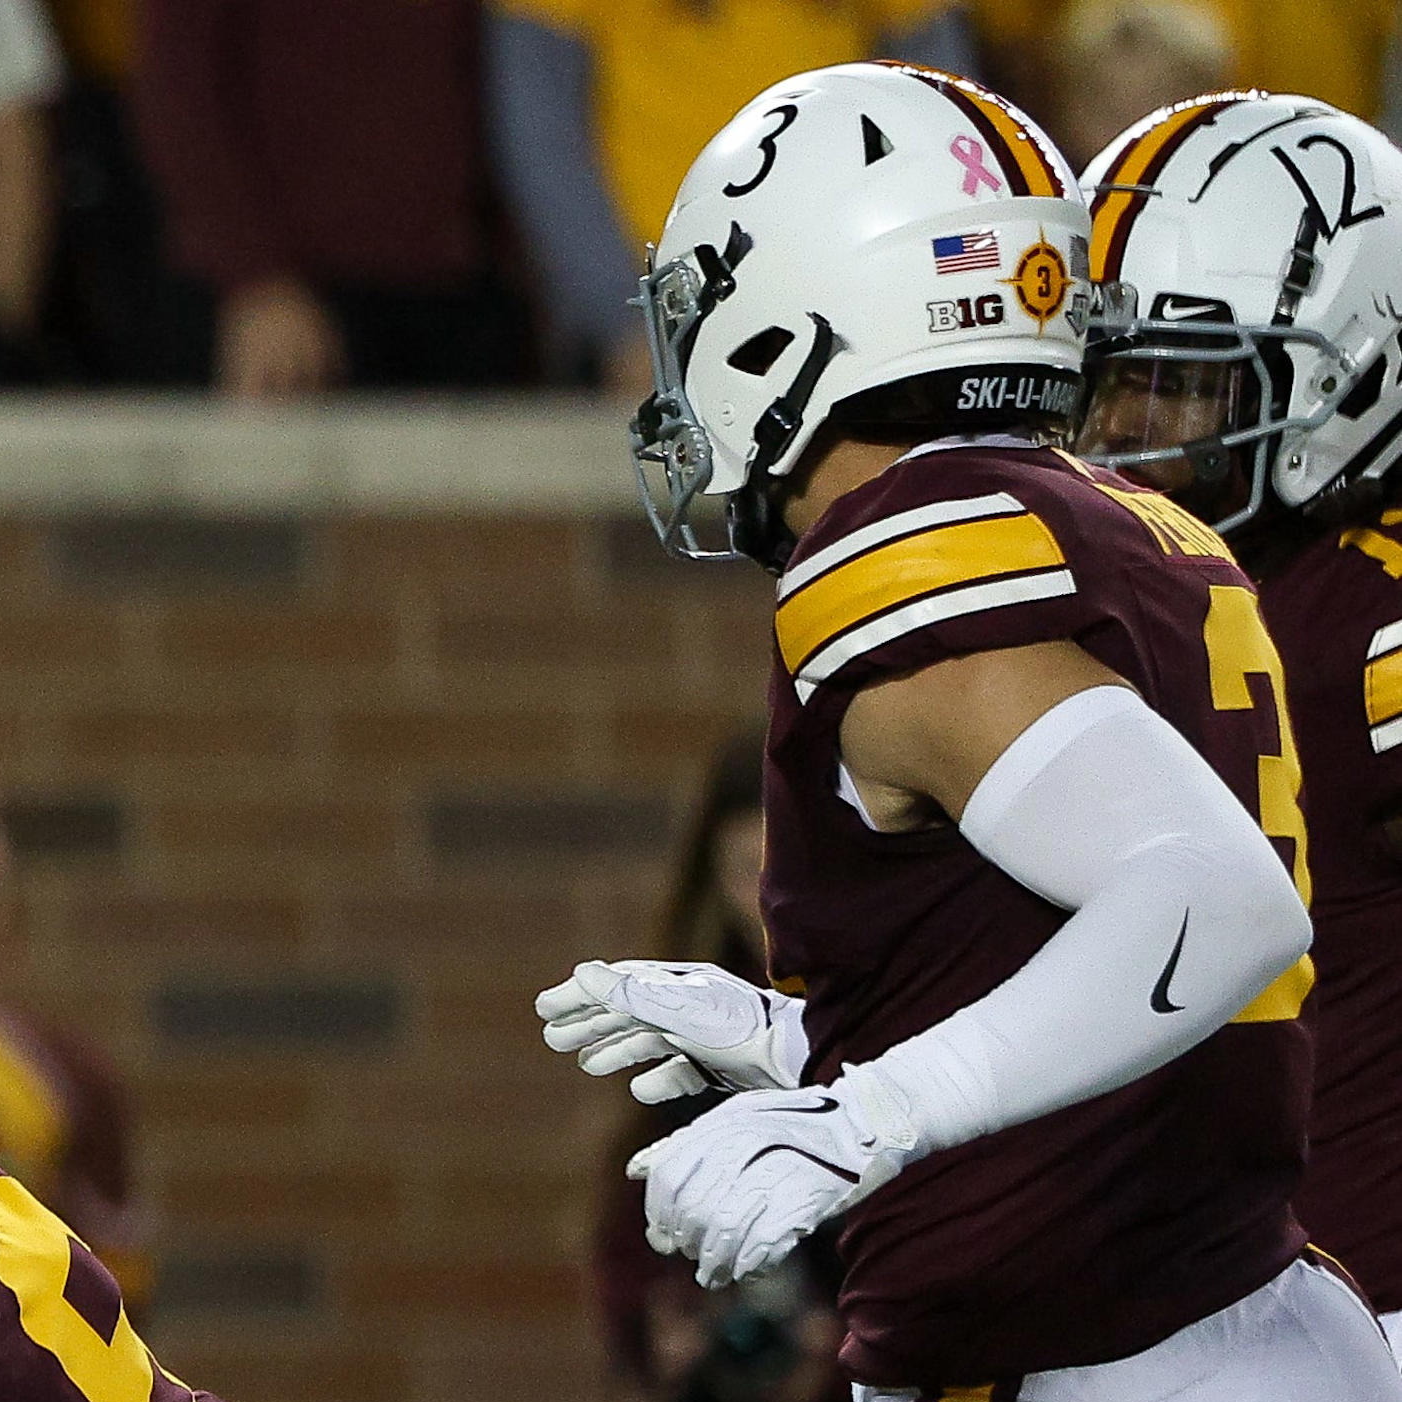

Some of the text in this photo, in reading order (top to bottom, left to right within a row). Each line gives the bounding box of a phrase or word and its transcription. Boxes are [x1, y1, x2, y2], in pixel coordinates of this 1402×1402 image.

[722, 104, 799, 198] 3
[1269, 134, 1385, 245] 12
[1037, 266, 1051, 298] 3
